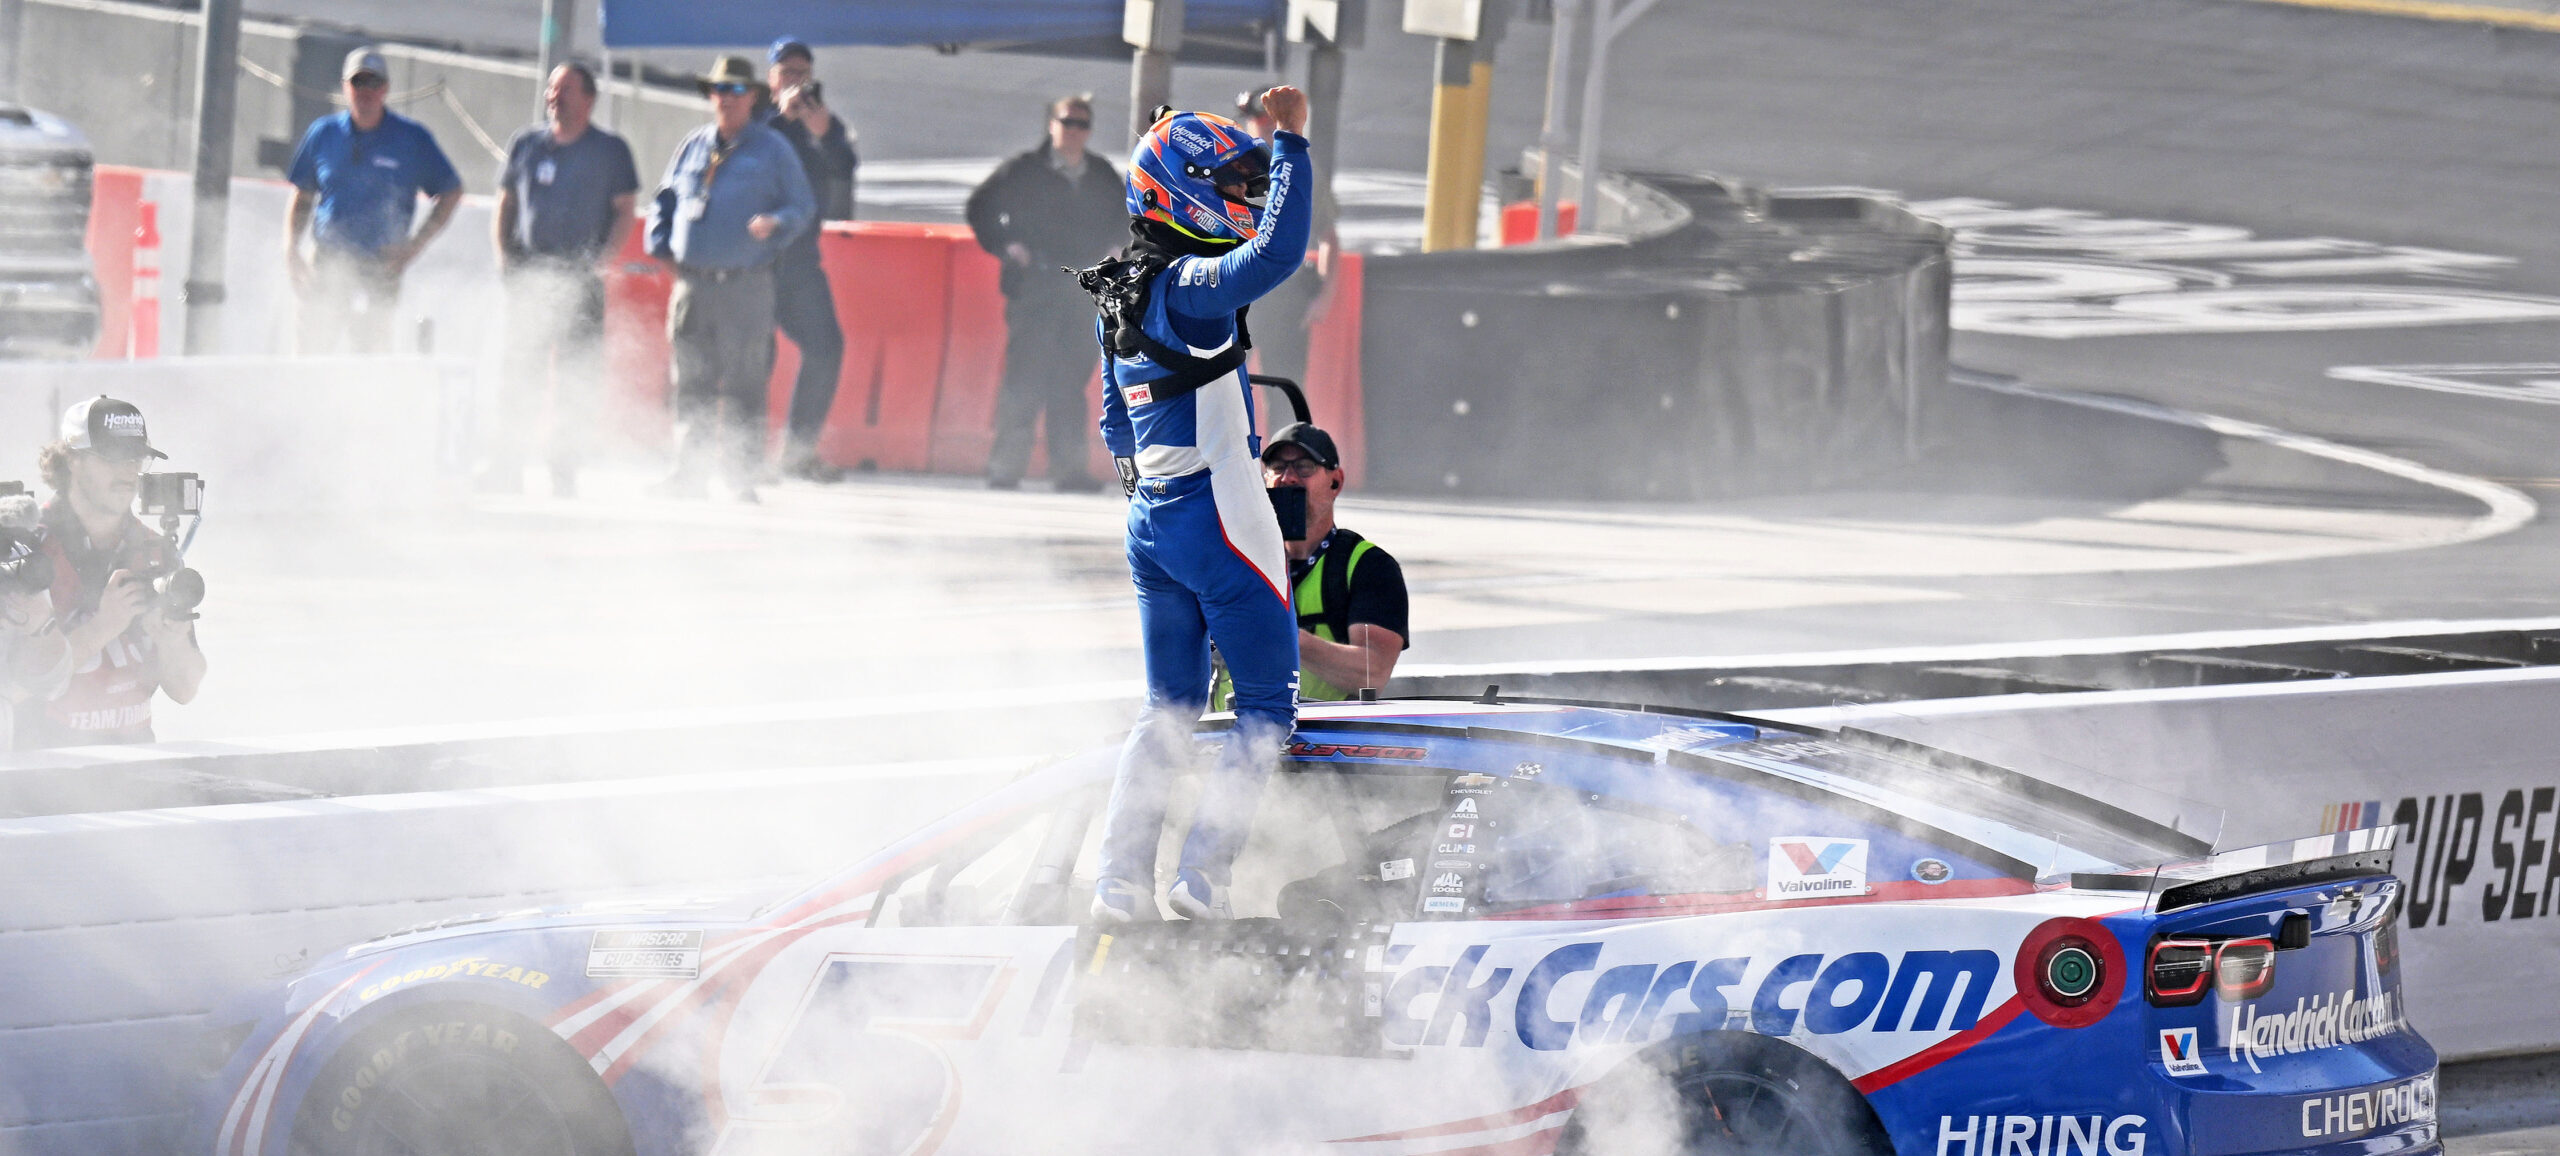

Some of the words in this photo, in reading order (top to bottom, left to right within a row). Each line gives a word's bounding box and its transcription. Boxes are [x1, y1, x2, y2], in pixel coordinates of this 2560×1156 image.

[1171, 124, 1213, 150] Hendrick
[1450, 788, 1493, 796] CHEVROLET
[1450, 812, 1479, 820] AXALTA
[1448, 823, 1475, 839] CI
[2392, 792, 2484, 929] CUP
[1432, 871, 1465, 888] MAC
[1777, 878, 1854, 893] Valvoline
[1432, 886, 1463, 894] TOOLS
[624, 931, 689, 947] NASCAR
[603, 952, 632, 967] CUP
[633, 951, 685, 967] SERIES
[358, 956, 550, 1001] GOODYEAR
[2168, 1062, 2200, 1073] Valvoline
[1936, 1114, 2148, 1156] HIRING
